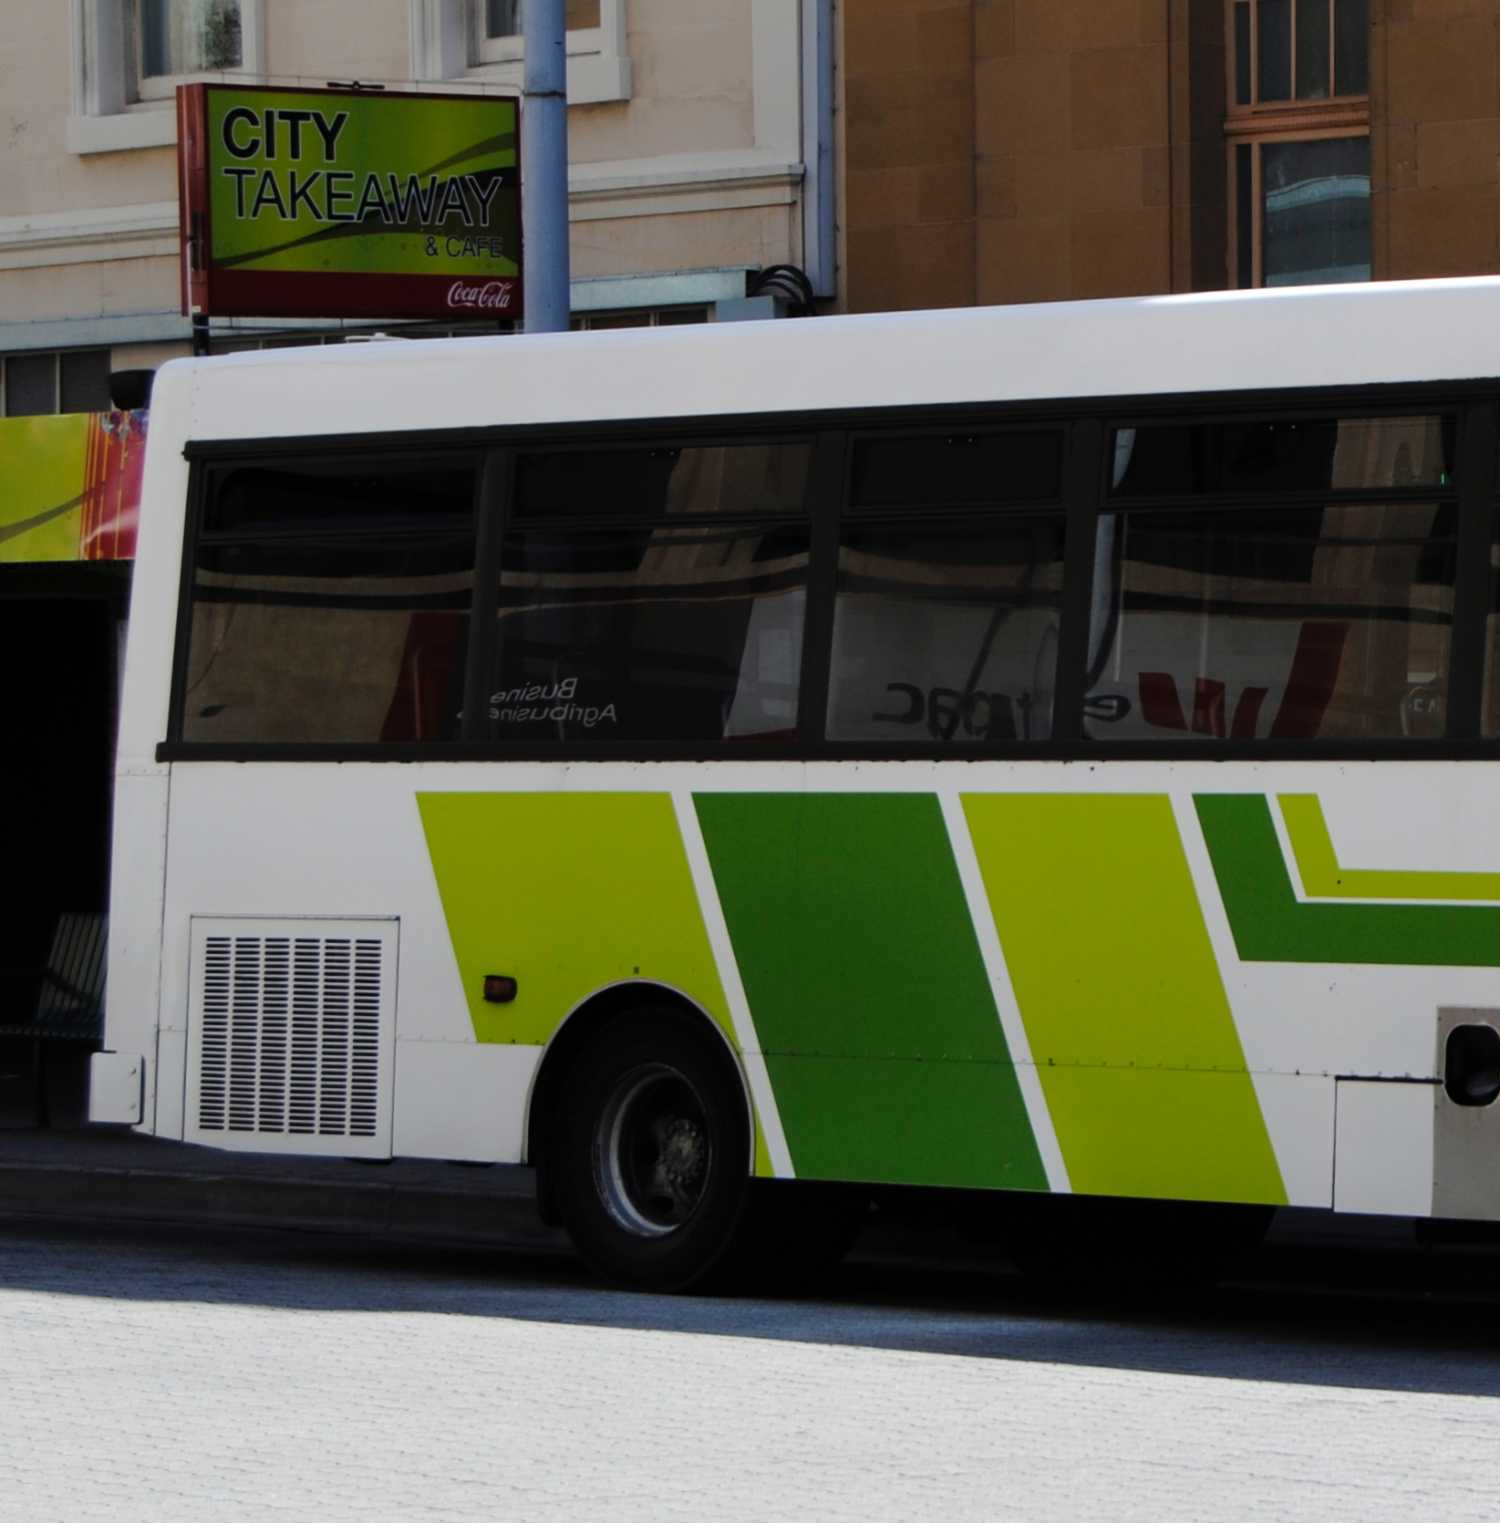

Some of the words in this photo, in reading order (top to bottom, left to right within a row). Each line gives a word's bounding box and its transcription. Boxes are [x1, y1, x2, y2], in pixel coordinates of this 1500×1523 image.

[221, 106, 349, 162] CITY
[222, 167, 503, 227] TAKEAWAY
[425, 236, 439, 257] &
[445, 235, 504, 258] CAFE
[447, 280, 513, 308] Coca-Cola
